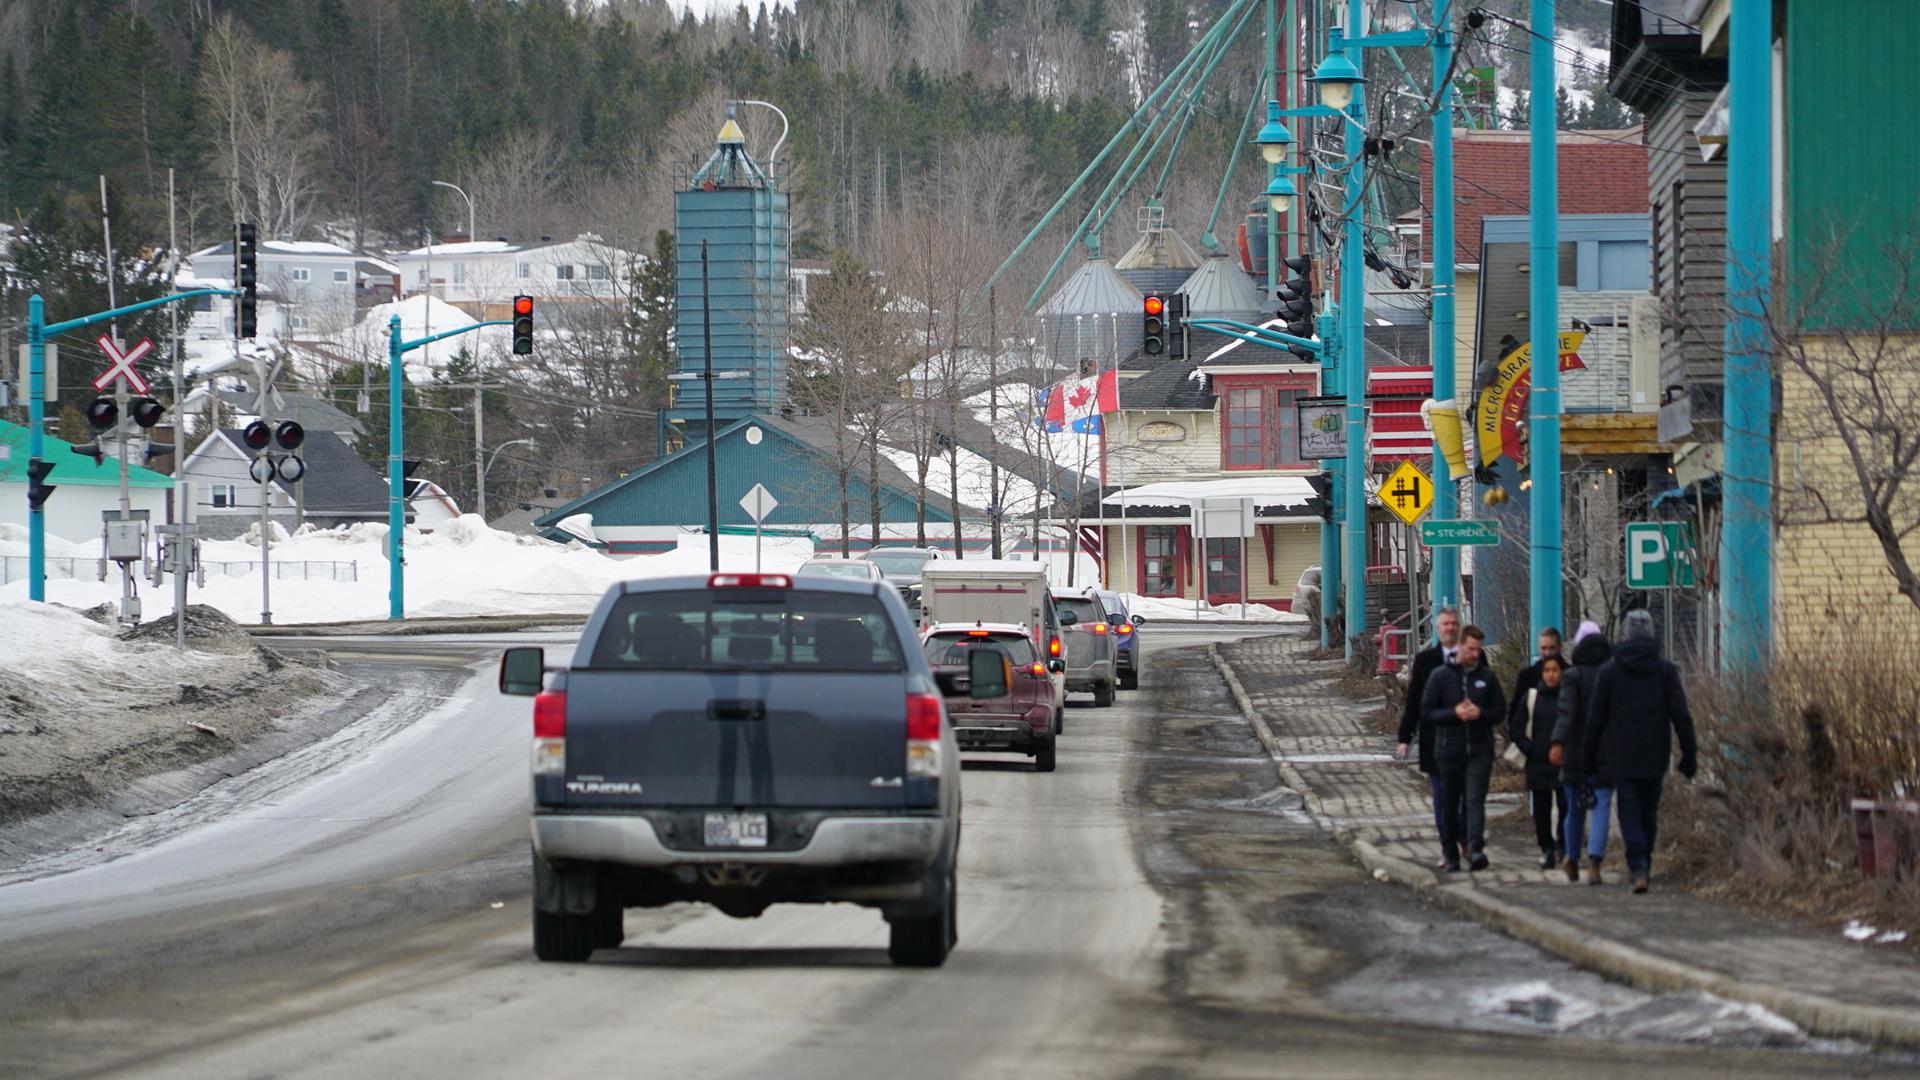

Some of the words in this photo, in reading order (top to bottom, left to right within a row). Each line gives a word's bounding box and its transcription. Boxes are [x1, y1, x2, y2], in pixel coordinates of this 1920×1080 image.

[1484, 337, 1571, 433] MICRO-BRASIE
[1631, 530, 1670, 581] P
[566, 781, 643, 795] TUNDRA
